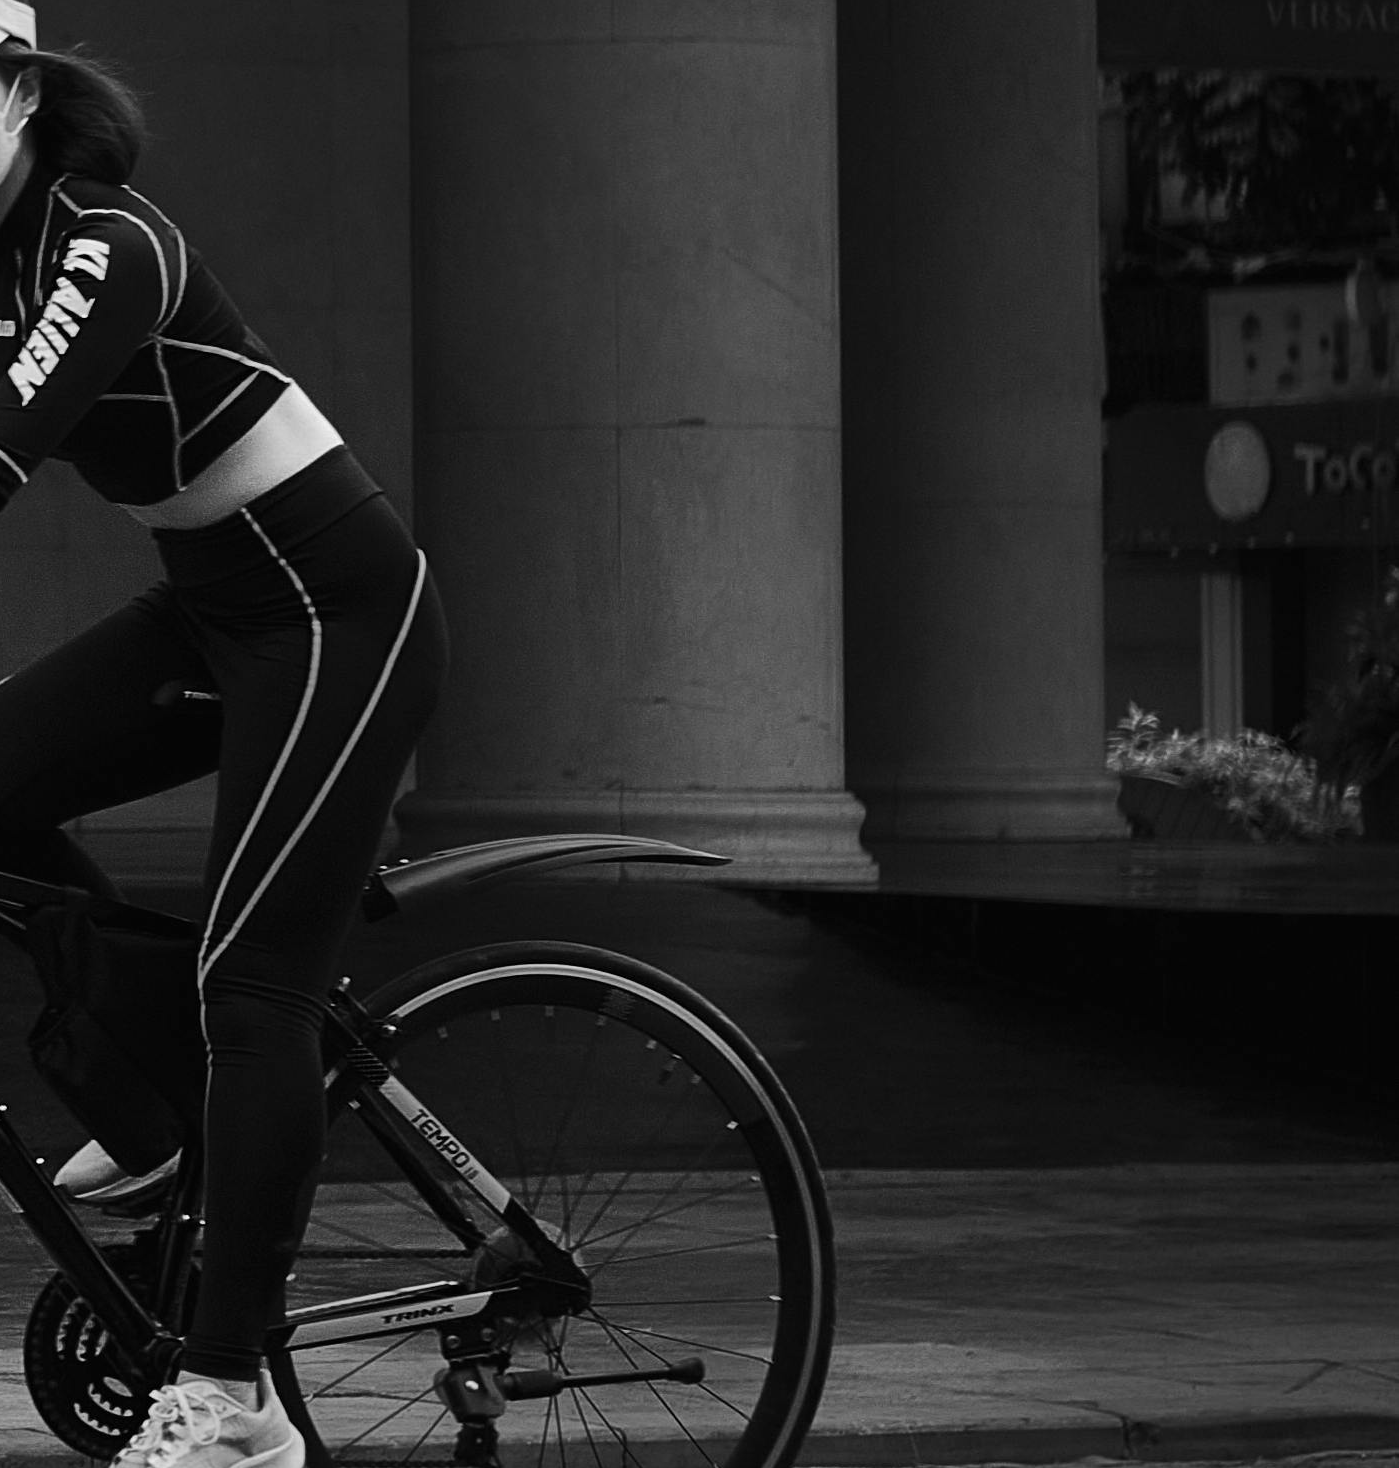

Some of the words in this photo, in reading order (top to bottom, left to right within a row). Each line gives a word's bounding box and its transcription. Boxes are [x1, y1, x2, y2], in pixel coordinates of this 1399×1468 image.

[7, 276, 95, 407] ALIEN
[411, 1108, 471, 1169] TEMPO
[382, 1303, 456, 1325] TRINX
